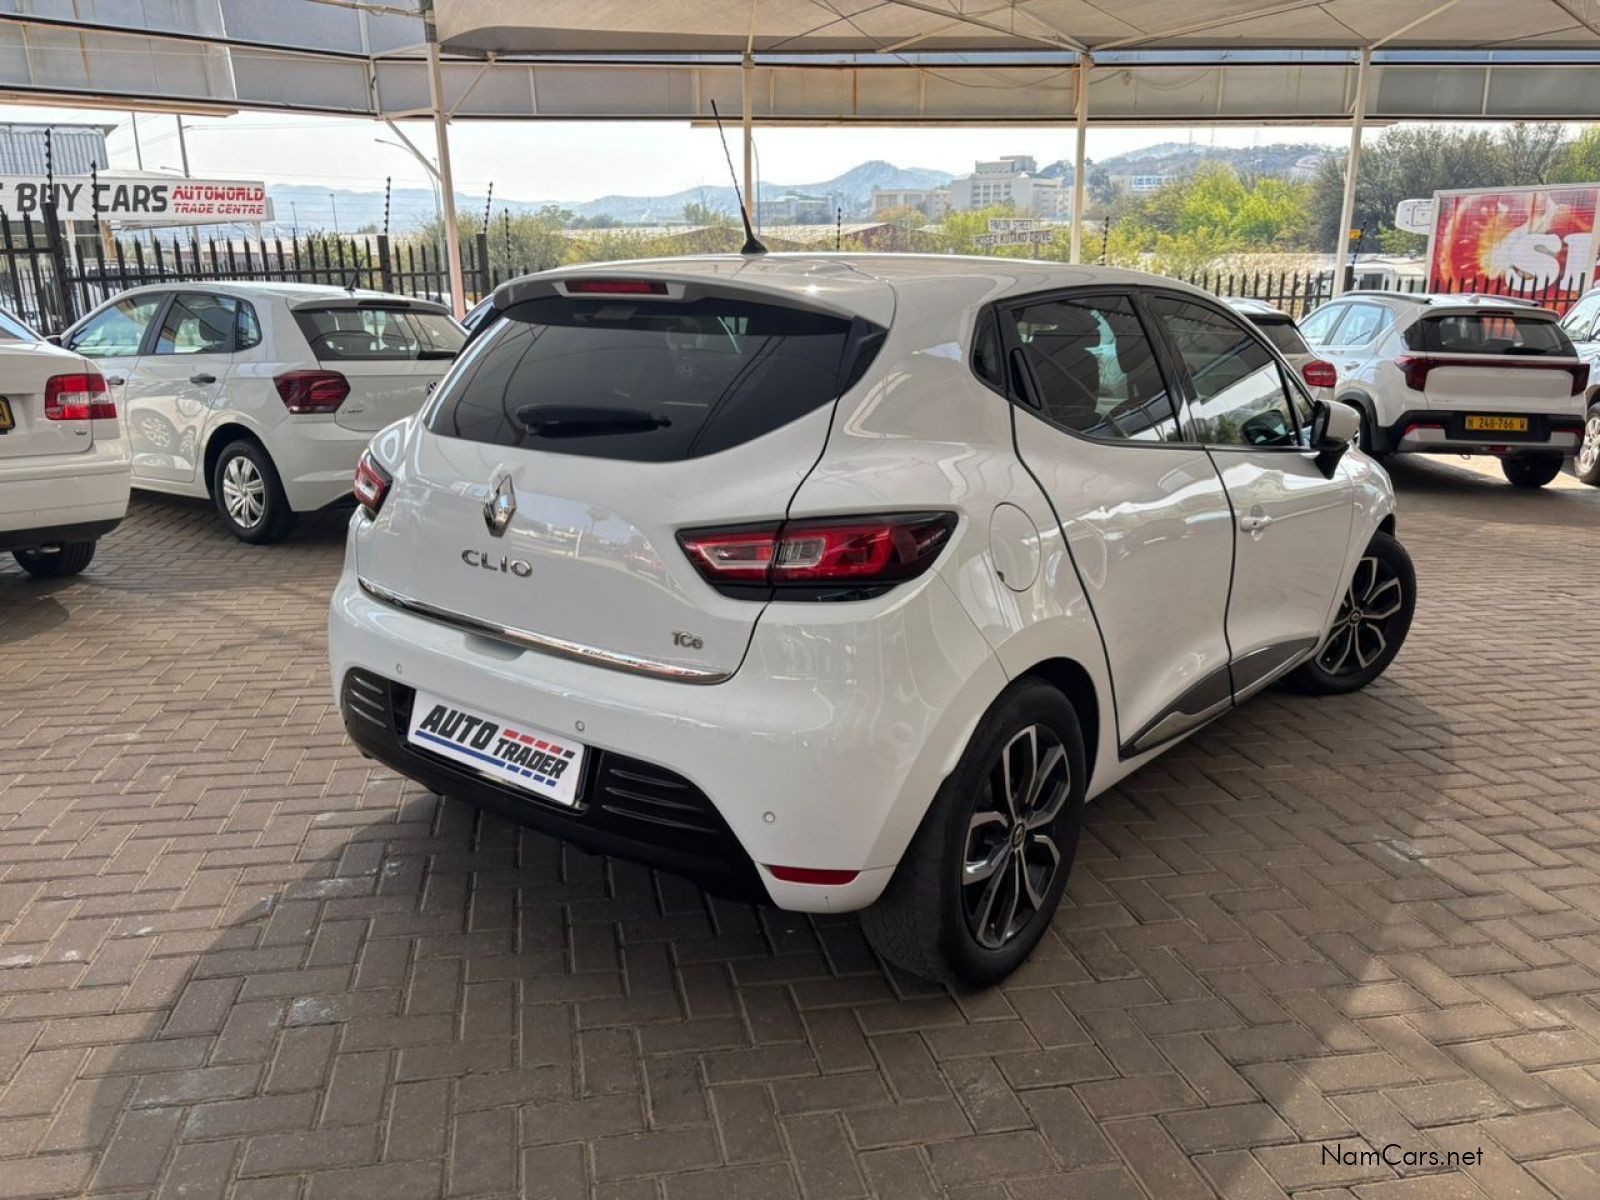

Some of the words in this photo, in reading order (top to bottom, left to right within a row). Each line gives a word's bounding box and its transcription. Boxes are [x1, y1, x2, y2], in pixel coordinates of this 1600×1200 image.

[15, 183, 83, 213] BUY
[96, 184, 168, 213] CARS
[172, 185, 264, 201] AUTOWORLD
[174, 203, 214, 214] TRADE
[217, 204, 264, 215] CENTRE
[461, 549, 533, 578] CLIO
[671, 630, 704, 649] TCe
[419, 704, 500, 751] AUTO
[492, 737, 569, 779] TRADER
